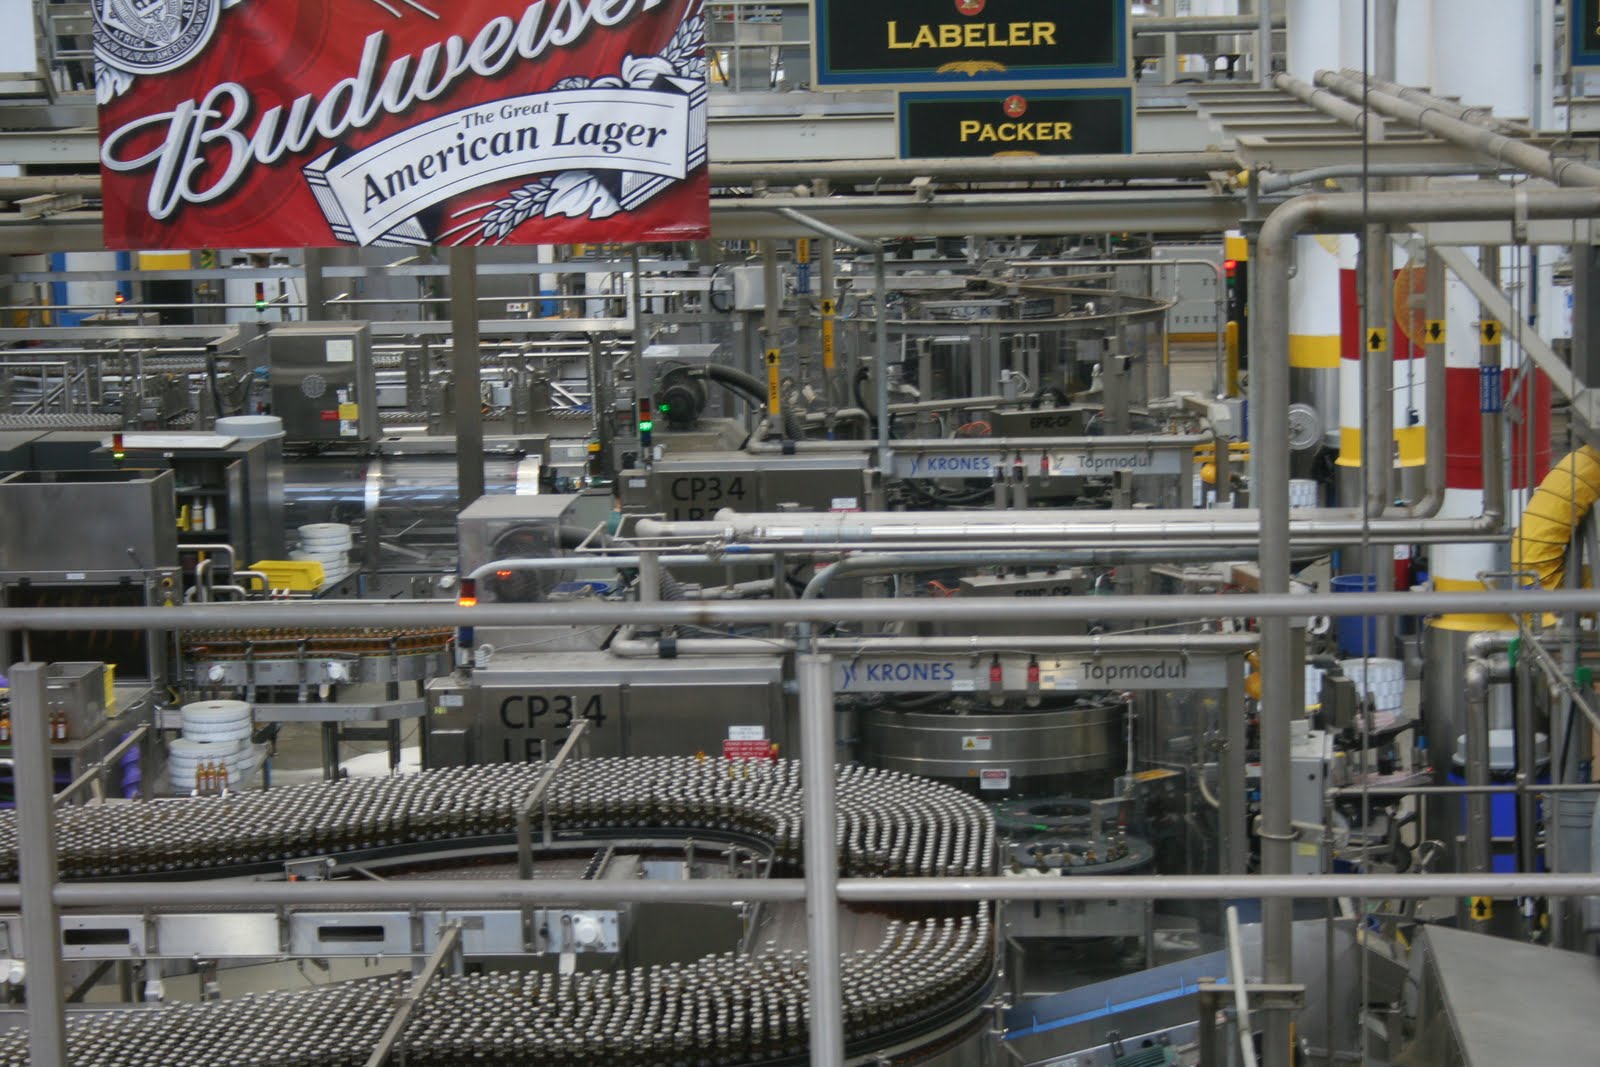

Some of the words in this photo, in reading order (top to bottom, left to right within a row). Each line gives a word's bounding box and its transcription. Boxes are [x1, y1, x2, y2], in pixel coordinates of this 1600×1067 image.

[112, 29, 146, 48] AFRICA
[154, 32, 194, 61] AMERICA
[887, 20, 1057, 50] LABELER
[101, 0, 660, 220] Budweise
[461, 112, 495, 130] The
[499, 100, 551, 120] Great
[959, 119, 1073, 142] PACKER
[362, 124, 540, 215] American
[551, 112, 668, 154] Lager
[927, 456, 991, 471] KRONES
[1078, 454, 1152, 470] Topmodul
[671, 477, 746, 501] CP34
[865, 662, 955, 682] KRONES
[1080, 659, 1188, 683] Topmodul
[500, 694, 607, 729] CP34
